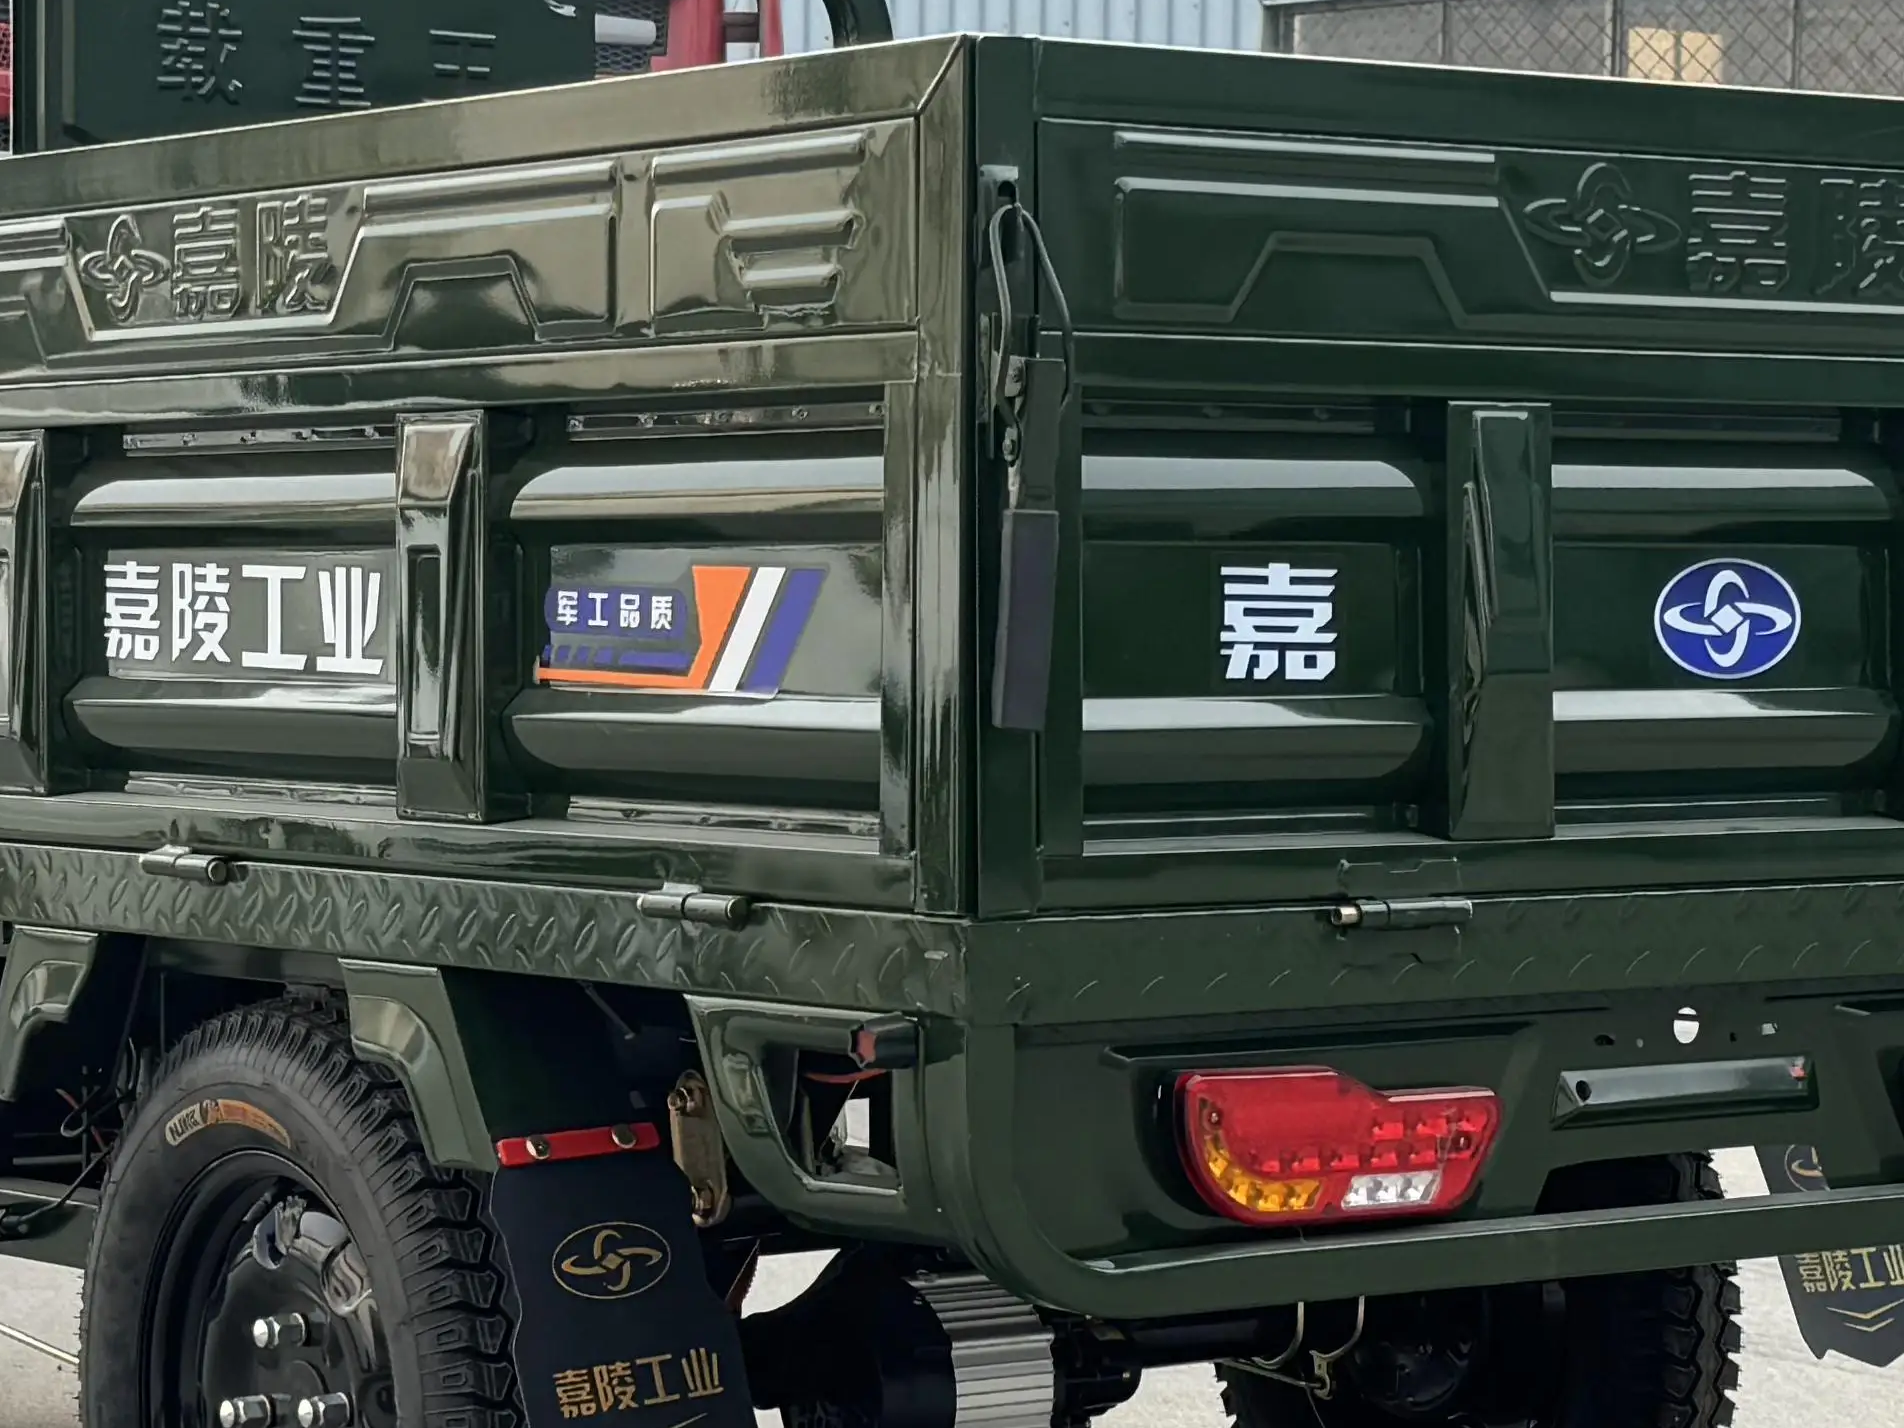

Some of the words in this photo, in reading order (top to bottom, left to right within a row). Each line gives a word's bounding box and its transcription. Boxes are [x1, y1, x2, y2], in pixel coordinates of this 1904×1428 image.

[170, 192, 332, 321] 嘉陵
[103, 560, 385, 676] 嘉陵工业
[556, 590, 673, 630] 军工品质
[1220, 563, 1339, 681] 嘉
[552, 1347, 725, 1419] 嘉陵工业
